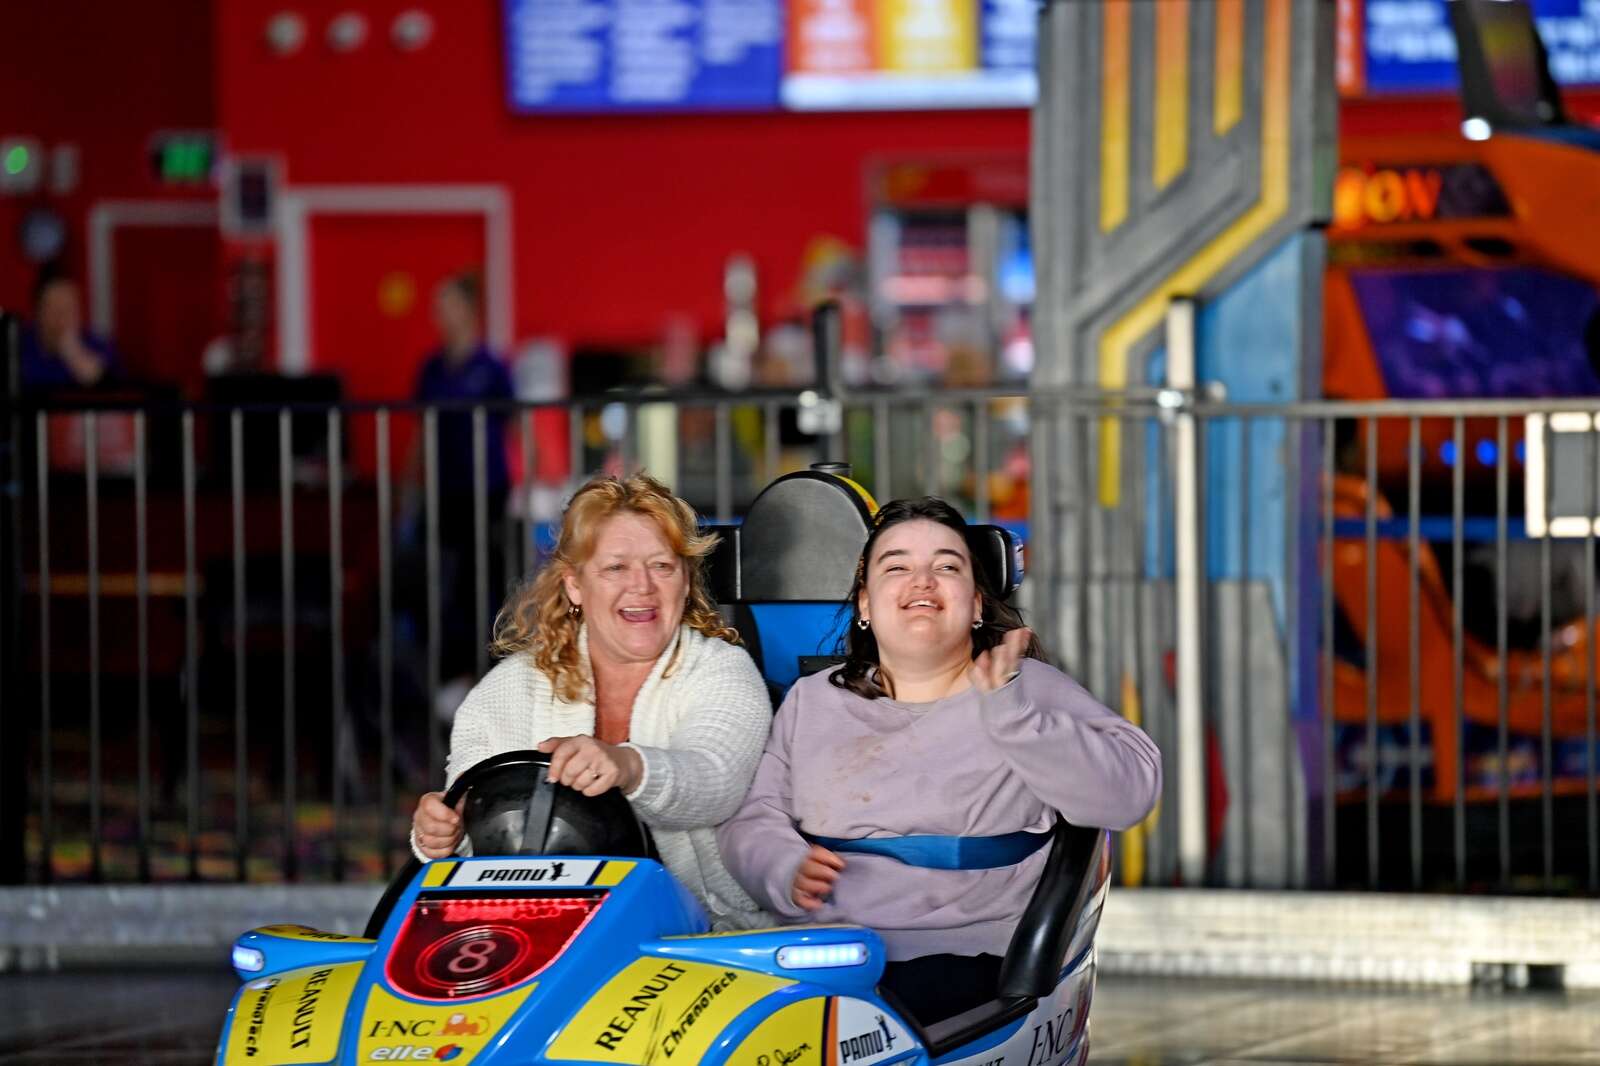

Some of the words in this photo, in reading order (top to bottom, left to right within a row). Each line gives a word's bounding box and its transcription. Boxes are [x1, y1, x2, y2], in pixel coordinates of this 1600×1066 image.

[477, 867, 549, 882] PAMU
[448, 940, 497, 974] 8
[290, 968, 334, 1050] REANULT
[595, 962, 687, 1052] REANULT
[839, 1029, 884, 1064] PAMU
